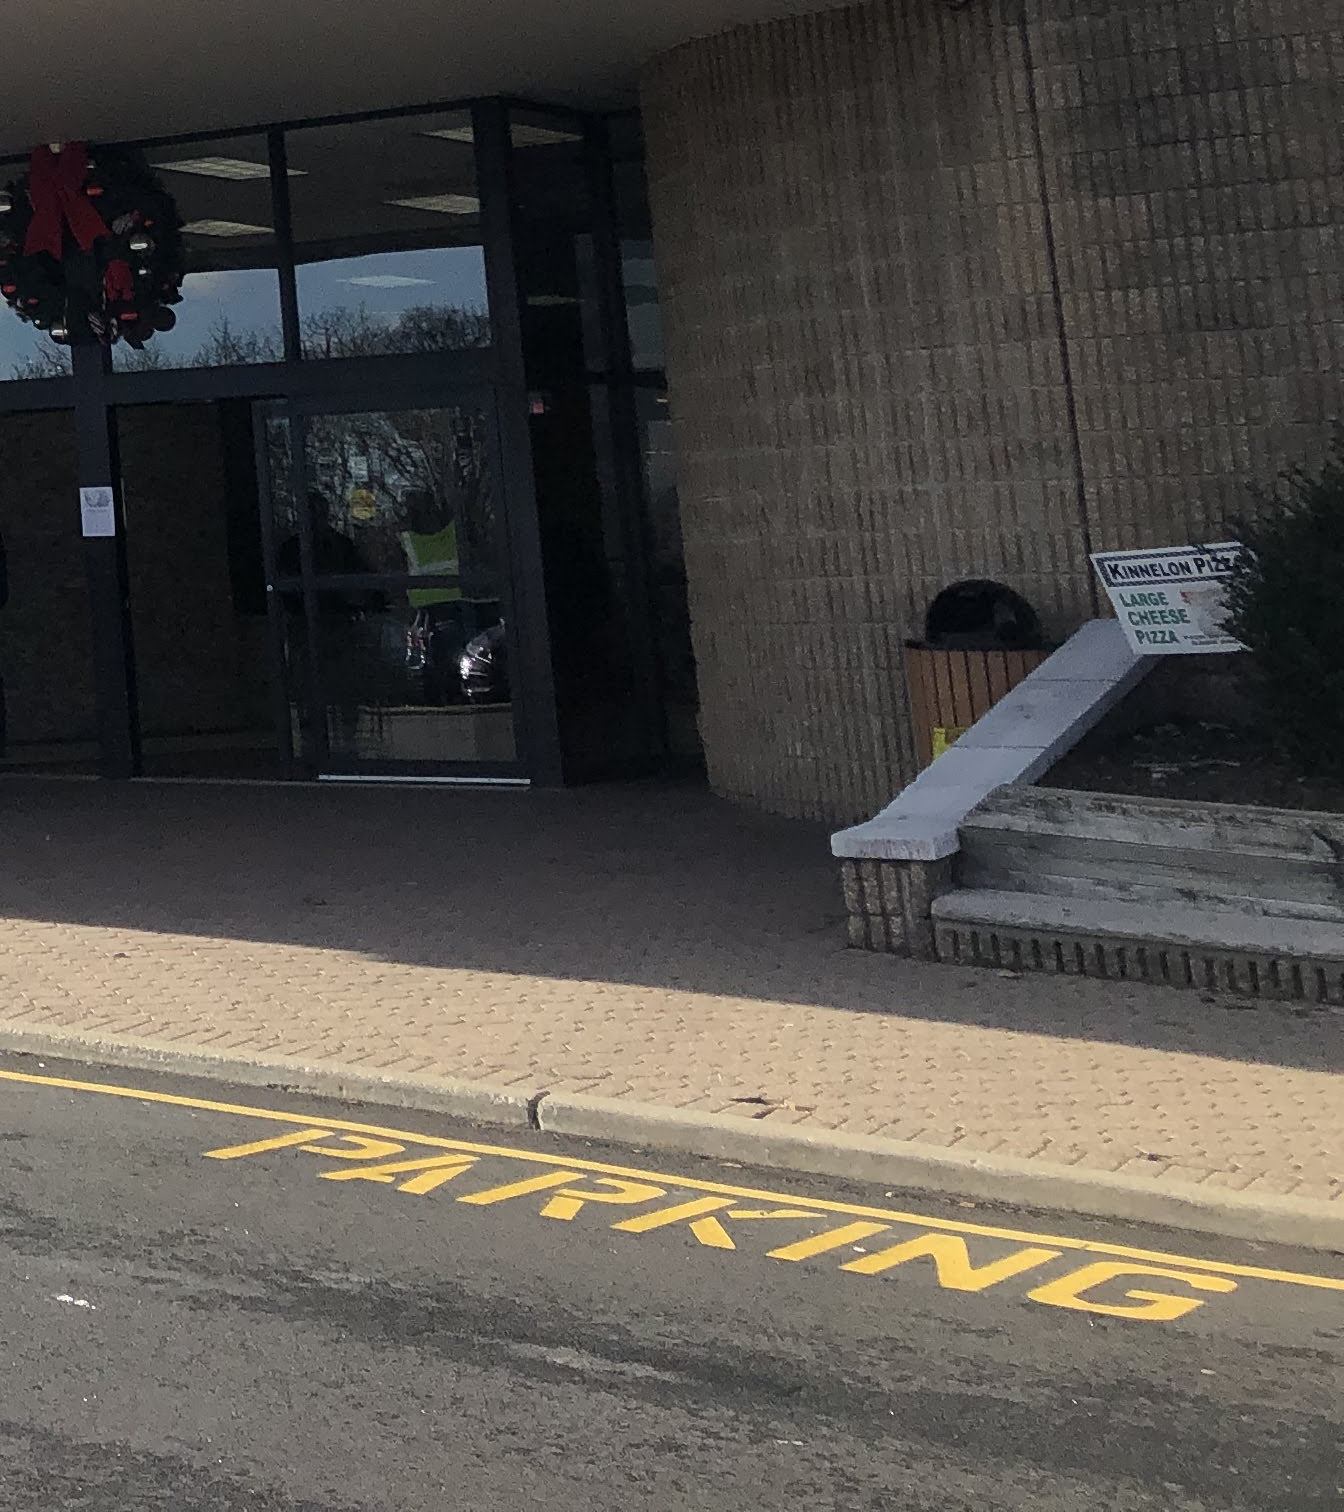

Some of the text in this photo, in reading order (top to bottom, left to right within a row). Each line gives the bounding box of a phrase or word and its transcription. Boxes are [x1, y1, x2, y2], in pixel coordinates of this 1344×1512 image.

[1107, 555, 1242, 580] KINNELON PIZZ
[1119, 592, 1169, 608] LARGE
[1127, 608, 1191, 626] CHEESE
[1134, 629, 1179, 645] PIZZA
[202, 1128, 1238, 1322] PARKING
